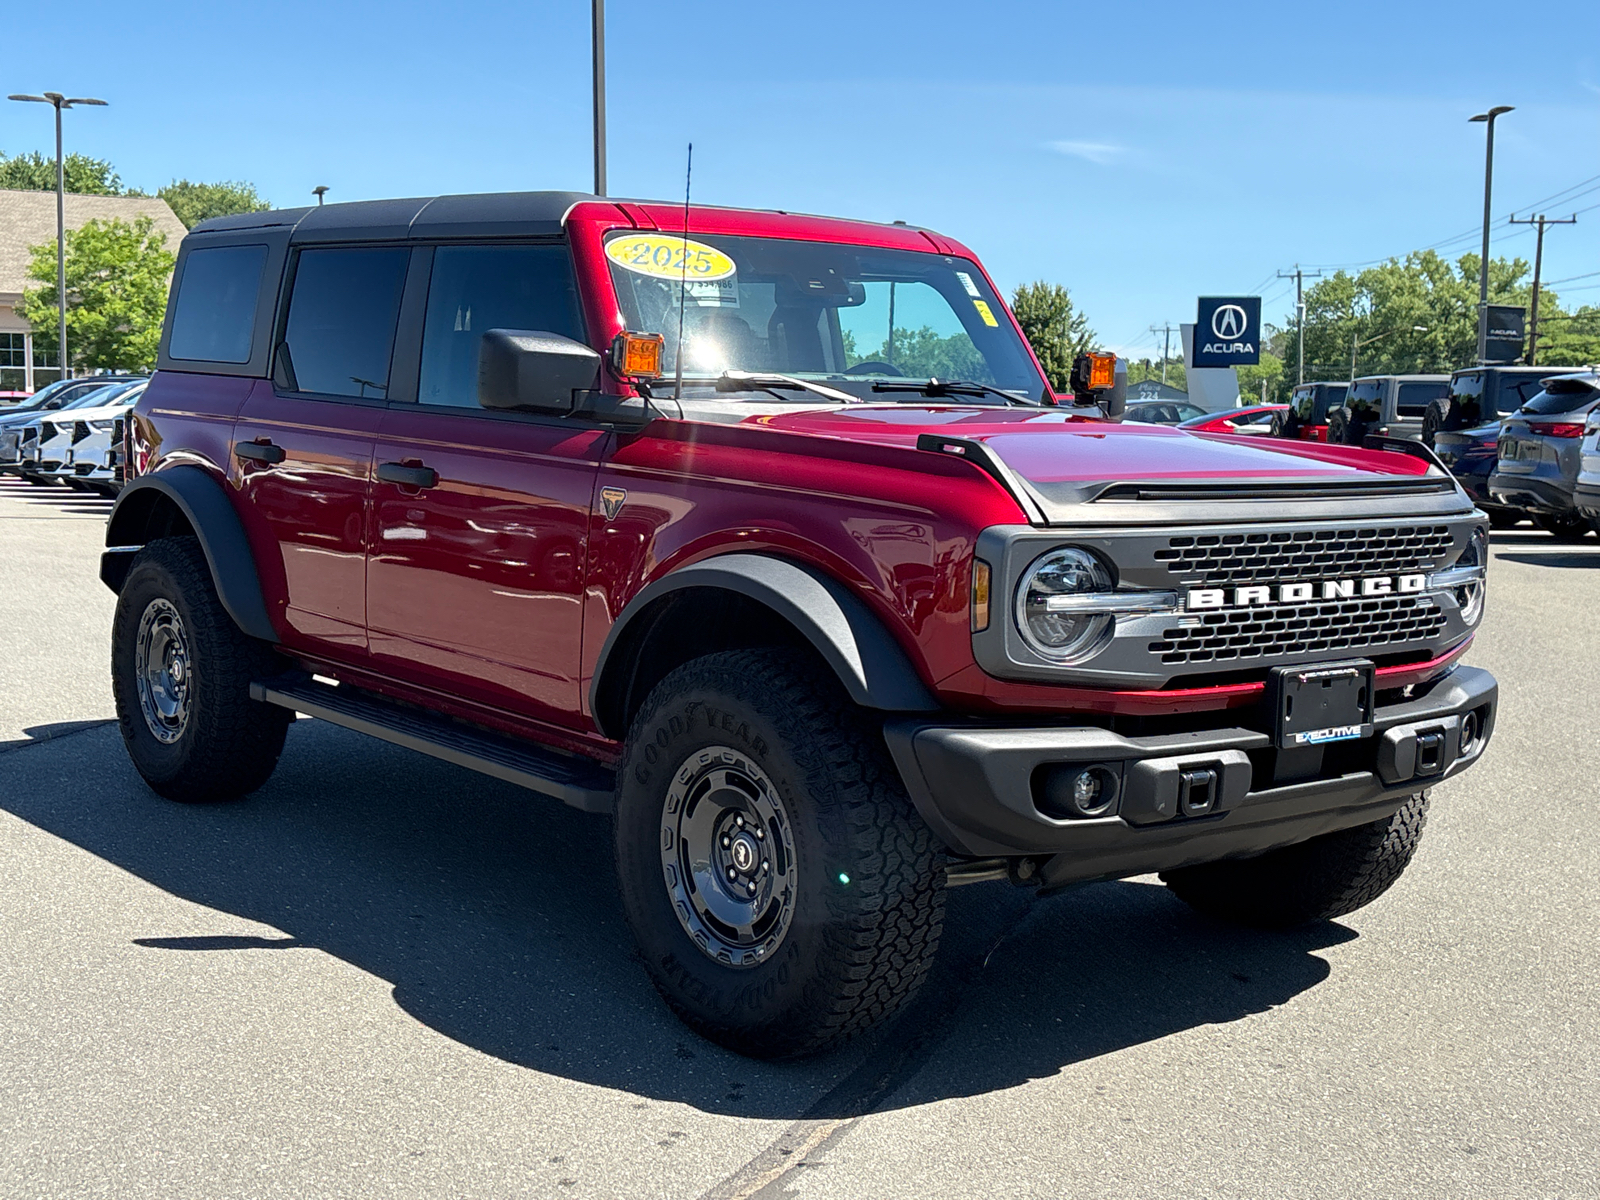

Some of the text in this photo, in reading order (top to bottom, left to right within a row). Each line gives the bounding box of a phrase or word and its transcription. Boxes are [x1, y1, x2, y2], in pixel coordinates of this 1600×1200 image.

[631, 243, 712, 272] 2025
[1202, 342, 1254, 354] ACURA
[1140, 391, 1159, 400] 224
[1187, 574, 1426, 609] BRONCO
[635, 701, 769, 785] GOODYEAR
[1295, 725, 1361, 744] EXECUTIVE
